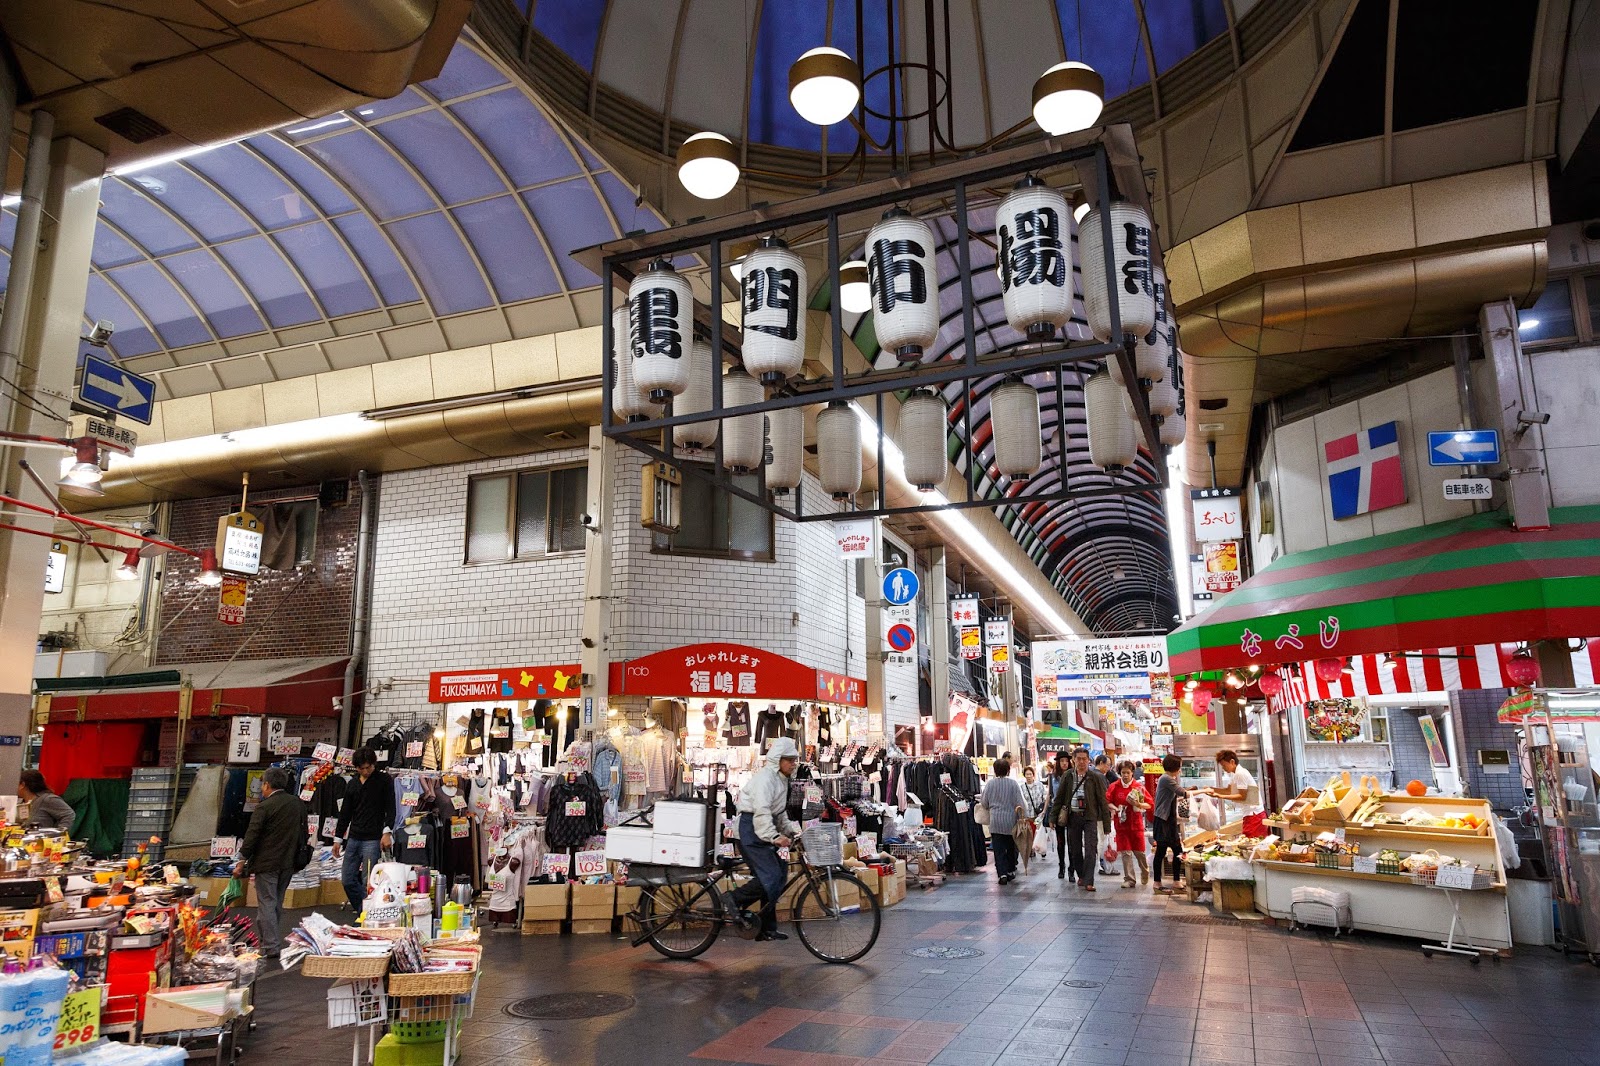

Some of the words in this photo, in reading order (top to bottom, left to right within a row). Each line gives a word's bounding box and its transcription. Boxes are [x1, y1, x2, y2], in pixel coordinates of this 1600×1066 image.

[89, 420, 136, 446] 自転車を除く
[1445, 483, 1490, 495] 自転車を除く
[1208, 575, 1239, 583] STAMP
[1241, 616, 1340, 657] なべじ
[685, 651, 760, 668] おしゃれします
[890, 655, 913, 663] 自動車
[1085, 650, 1163, 670] 親栄会通り
[440, 683, 498, 697] FUKUSHIMAYA
[690, 671, 757, 694] 福嶋屋
[237, 721, 251, 757] 豆乳
[579, 861, 604, 873] 105
[53, 1025, 94, 1050] 298
